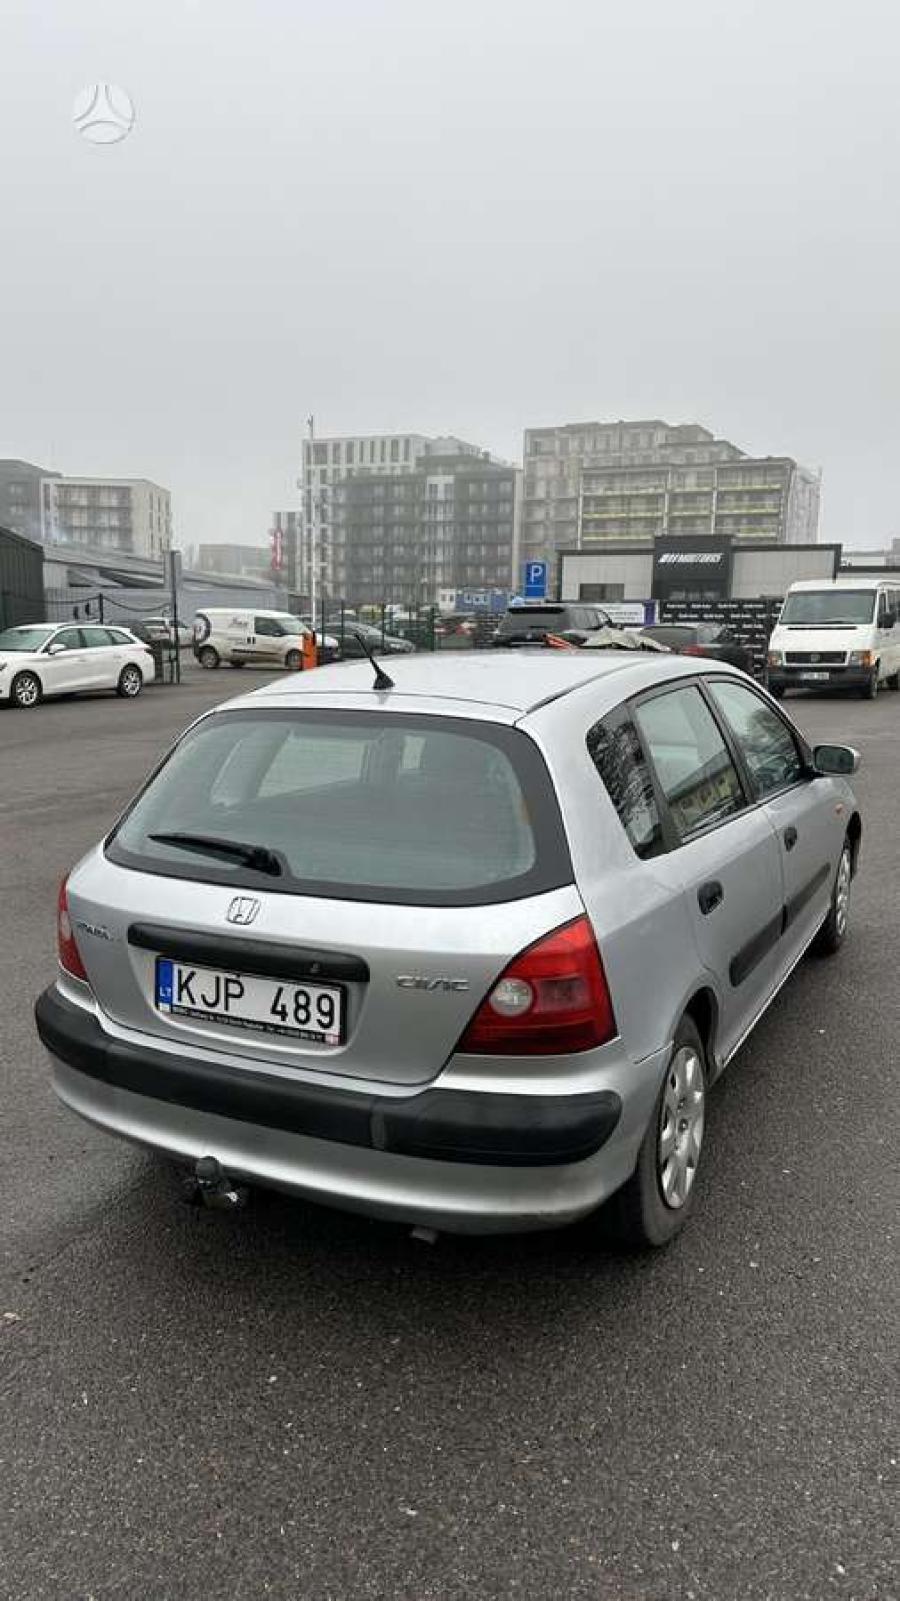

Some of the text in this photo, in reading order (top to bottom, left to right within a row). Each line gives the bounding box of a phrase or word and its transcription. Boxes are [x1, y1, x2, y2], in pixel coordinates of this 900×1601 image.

[531, 565, 543, 584] P
[178, 968, 244, 1012] KJP
[270, 986, 335, 1029] 489
